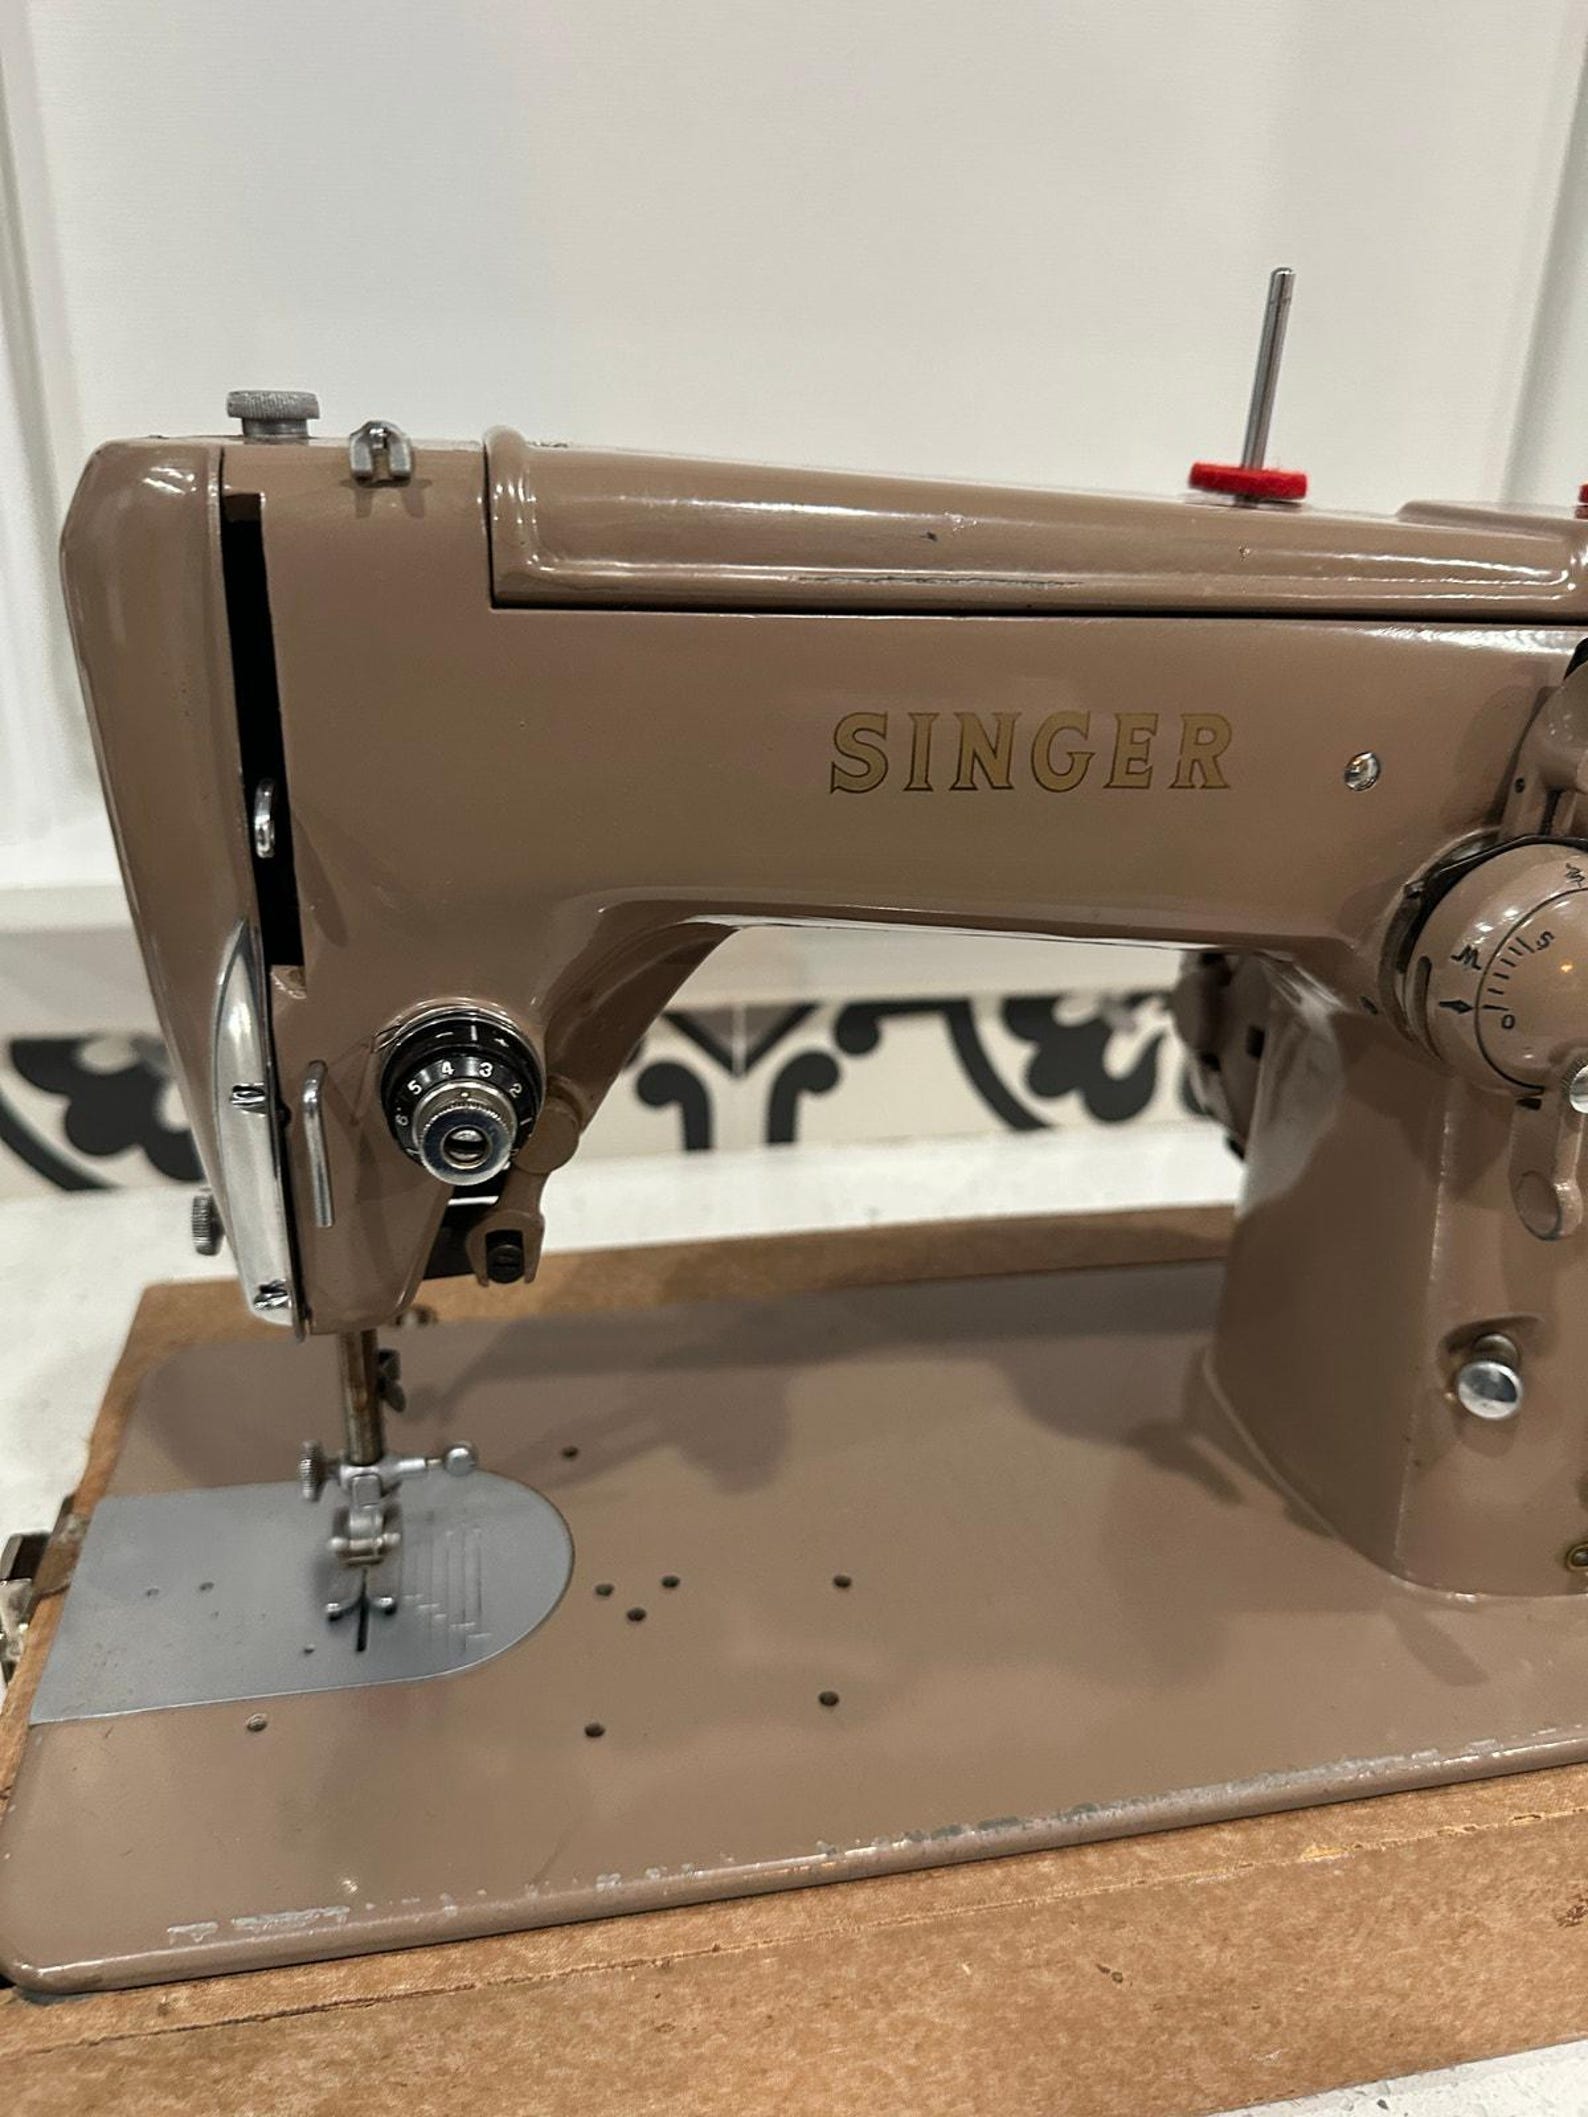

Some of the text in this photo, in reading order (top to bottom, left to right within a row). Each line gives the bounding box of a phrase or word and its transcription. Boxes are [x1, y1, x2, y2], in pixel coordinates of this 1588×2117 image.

[830, 710, 1232, 794] SINGER
[407, 1080, 422, 1095] 5
[441, 1060, 455, 1076] 4
[479, 1062, 493, 1078] 3
[509, 1083, 523, 1099] 2
